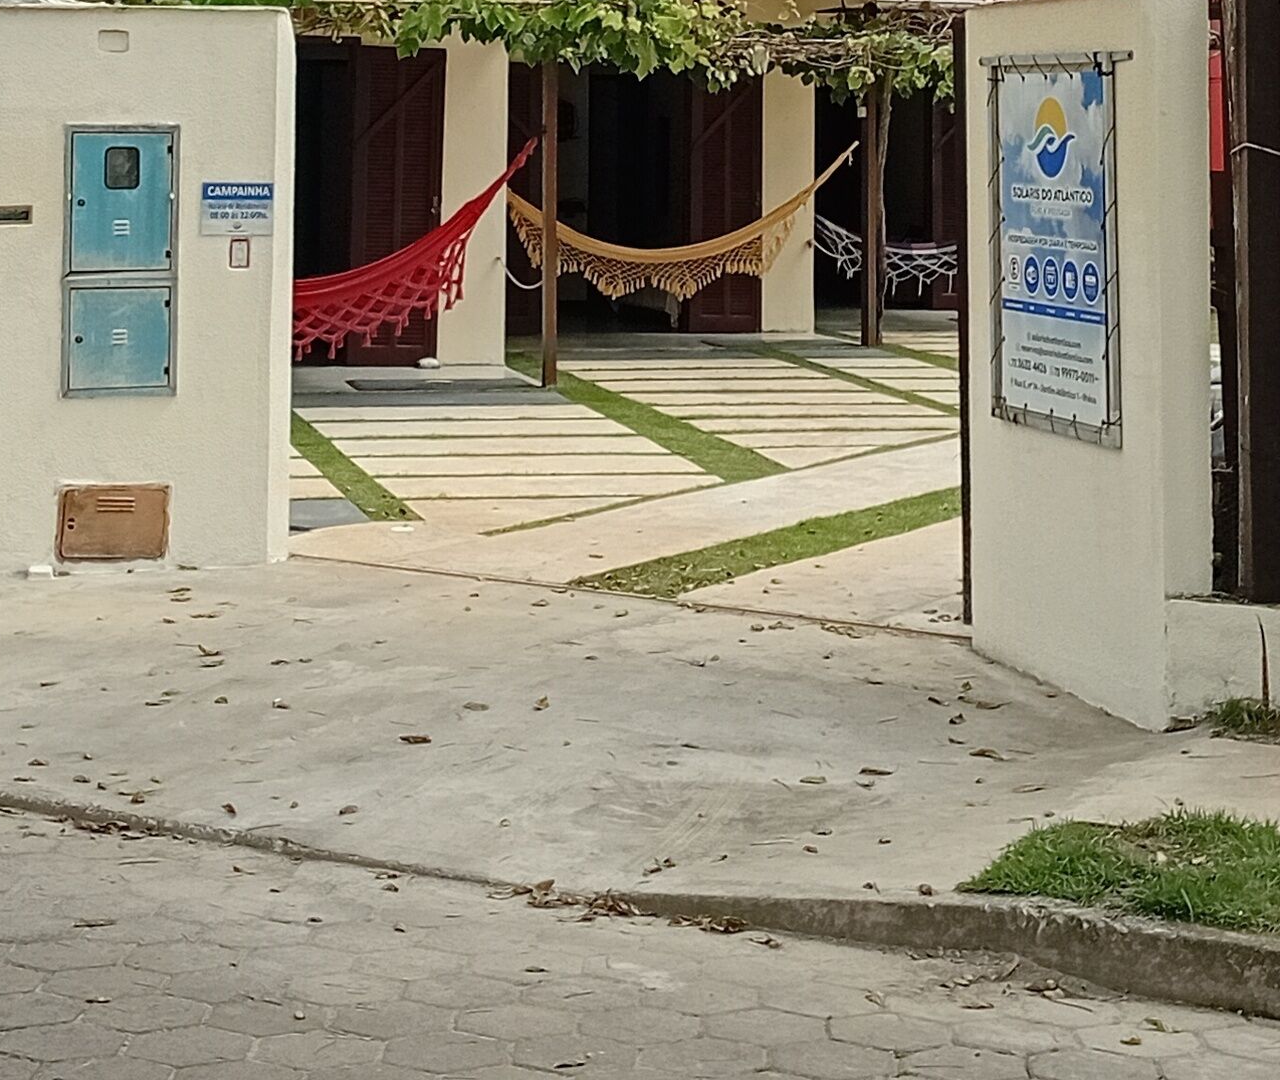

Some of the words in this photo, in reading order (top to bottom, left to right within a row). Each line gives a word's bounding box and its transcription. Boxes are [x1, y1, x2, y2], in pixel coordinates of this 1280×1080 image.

[207, 185, 271, 196] CAMPAINHA
[1013, 186, 1040, 200] SOLARIS
[1041, 188, 1052, 201] DO
